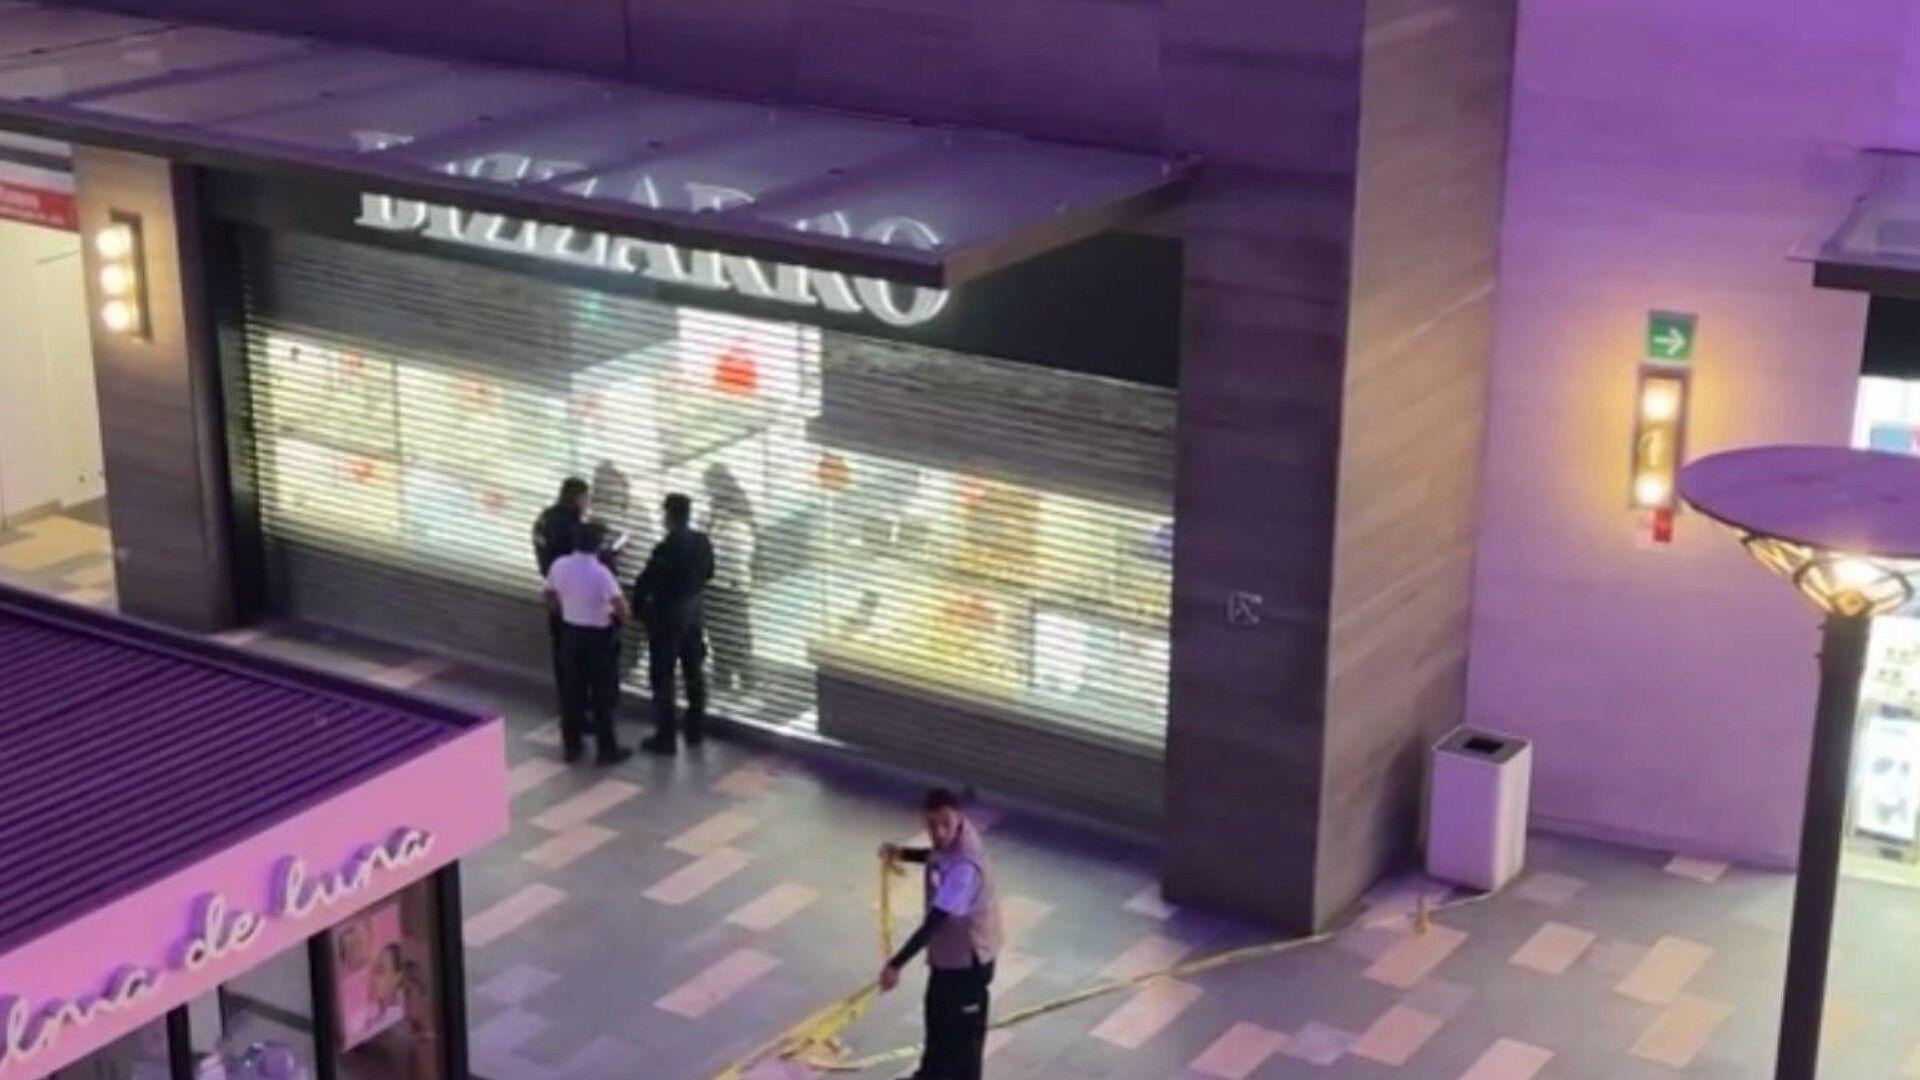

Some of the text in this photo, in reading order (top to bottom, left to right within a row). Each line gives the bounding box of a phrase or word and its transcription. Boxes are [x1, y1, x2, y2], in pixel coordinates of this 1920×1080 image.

[0, 828, 434, 1071] lma de luna
